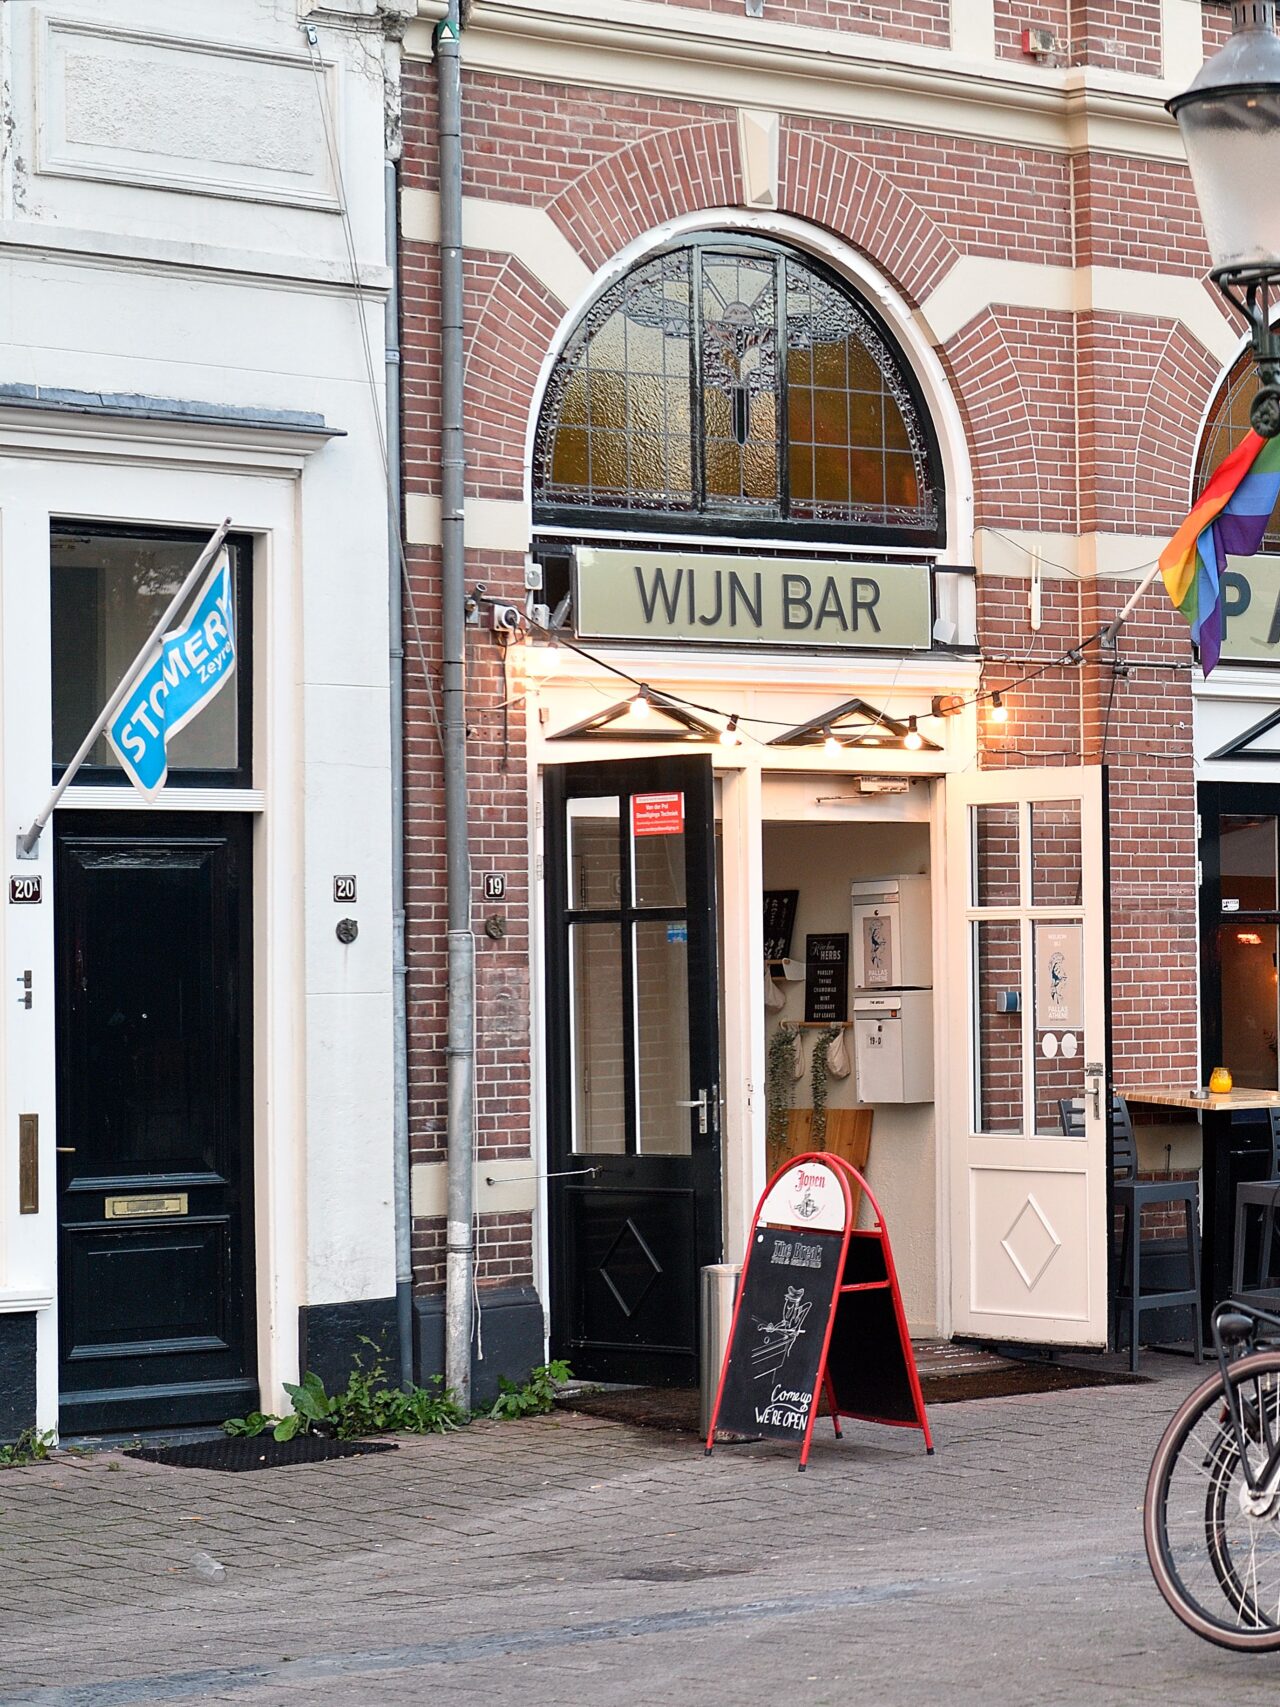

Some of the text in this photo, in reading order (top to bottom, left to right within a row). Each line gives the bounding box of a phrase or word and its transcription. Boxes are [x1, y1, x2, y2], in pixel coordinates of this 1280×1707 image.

[634, 566, 882, 633] WIJN BAR
[337, 879, 355, 897] 20
[488, 877, 503, 895] 19
[820, 950, 841, 960] HERBS
[794, 1169, 825, 1191] Jopen
[772, 1239, 822, 1261] The Break
[771, 1383, 800, 1401] Come
[755, 1406, 808, 1430] WE'RE OPEN
